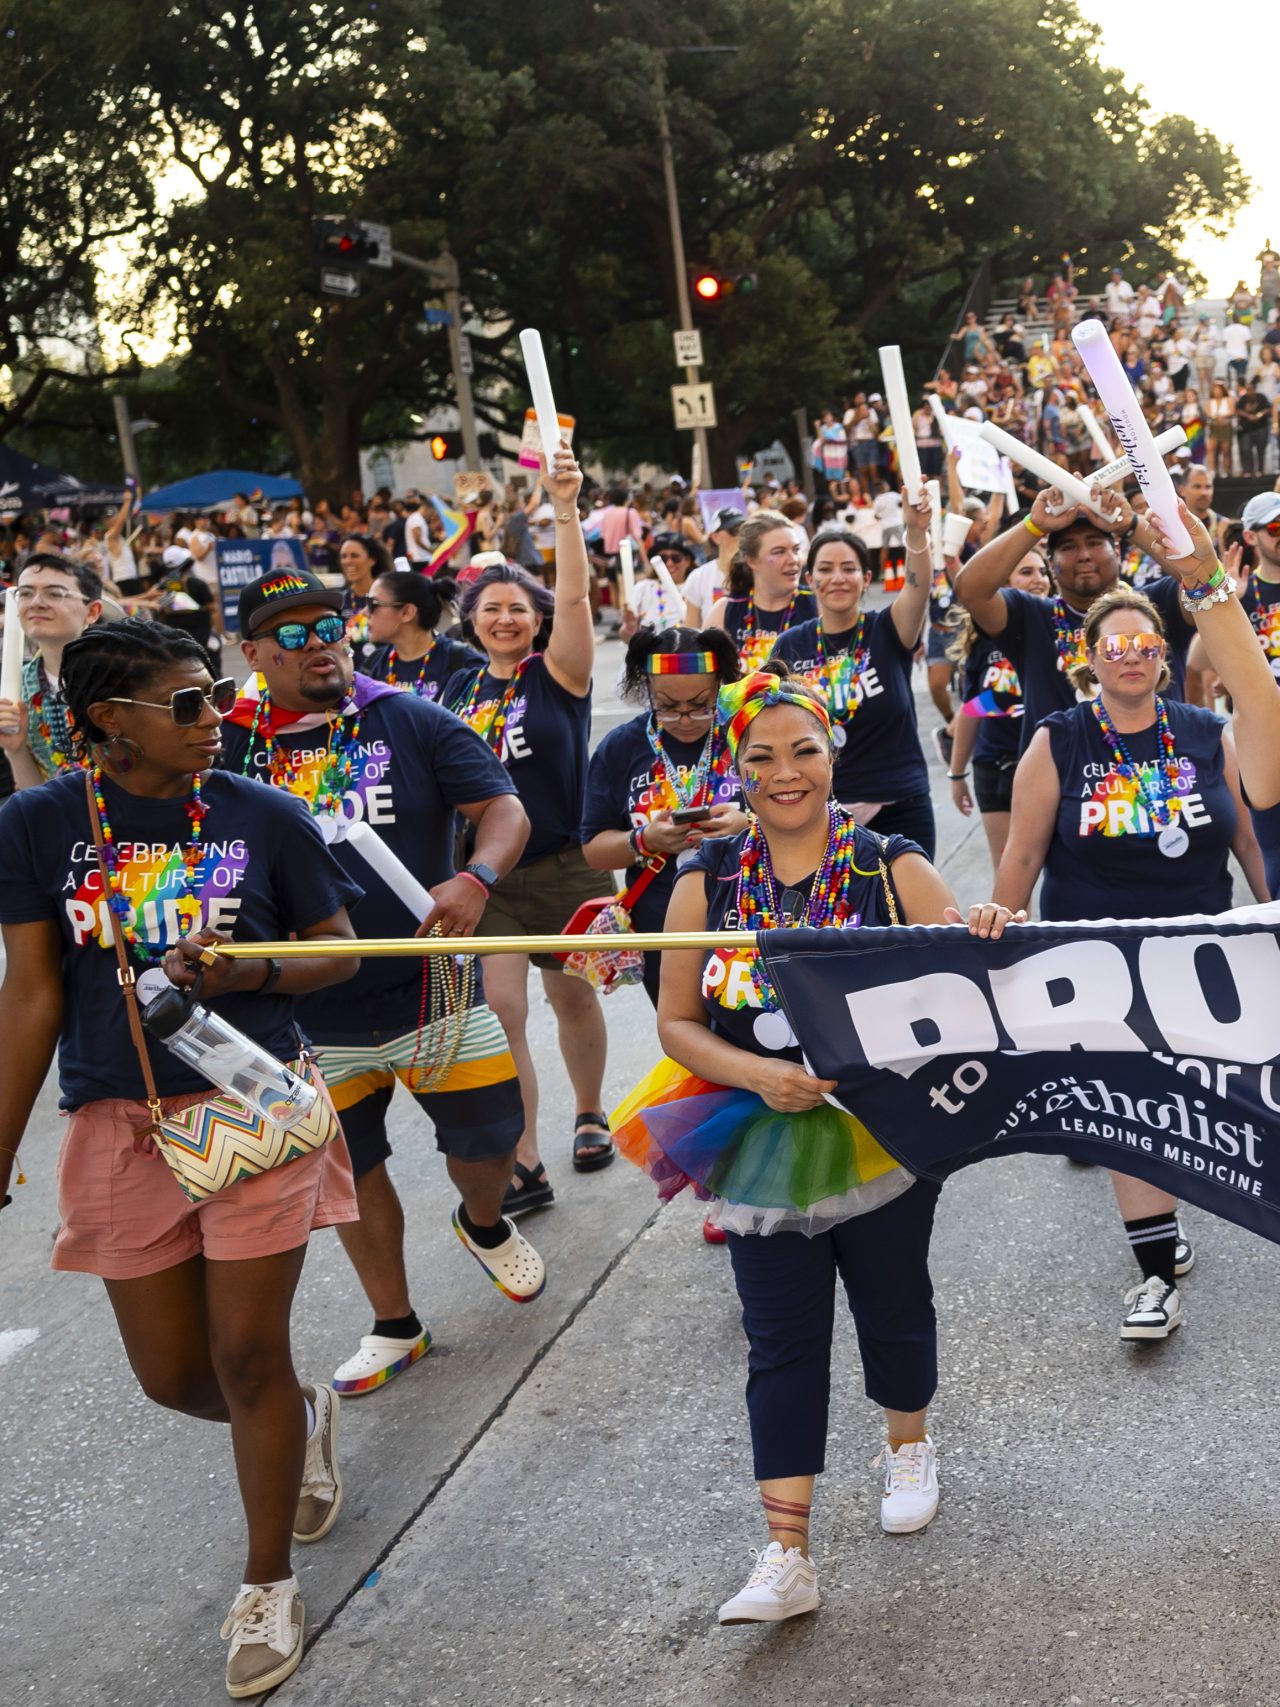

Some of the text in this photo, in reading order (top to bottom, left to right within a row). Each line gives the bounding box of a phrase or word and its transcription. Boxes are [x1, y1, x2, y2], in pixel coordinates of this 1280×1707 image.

[1120, 409, 1138, 441] HOUSTON
[364, 761, 391, 780] OF
[1081, 782, 1093, 798] A
[1176, 775, 1197, 790] OF
[719, 782, 741, 797] OF
[1079, 793, 1212, 836] PRIDE
[62, 871, 77, 891] A
[212, 866, 246, 889] OF
[65, 896, 243, 946] PRIDE
[928, 1060, 989, 1116] to
[1030, 1079, 1264, 1169] ethodist
[1061, 1117, 1262, 1197] LEADING MEDICINE
